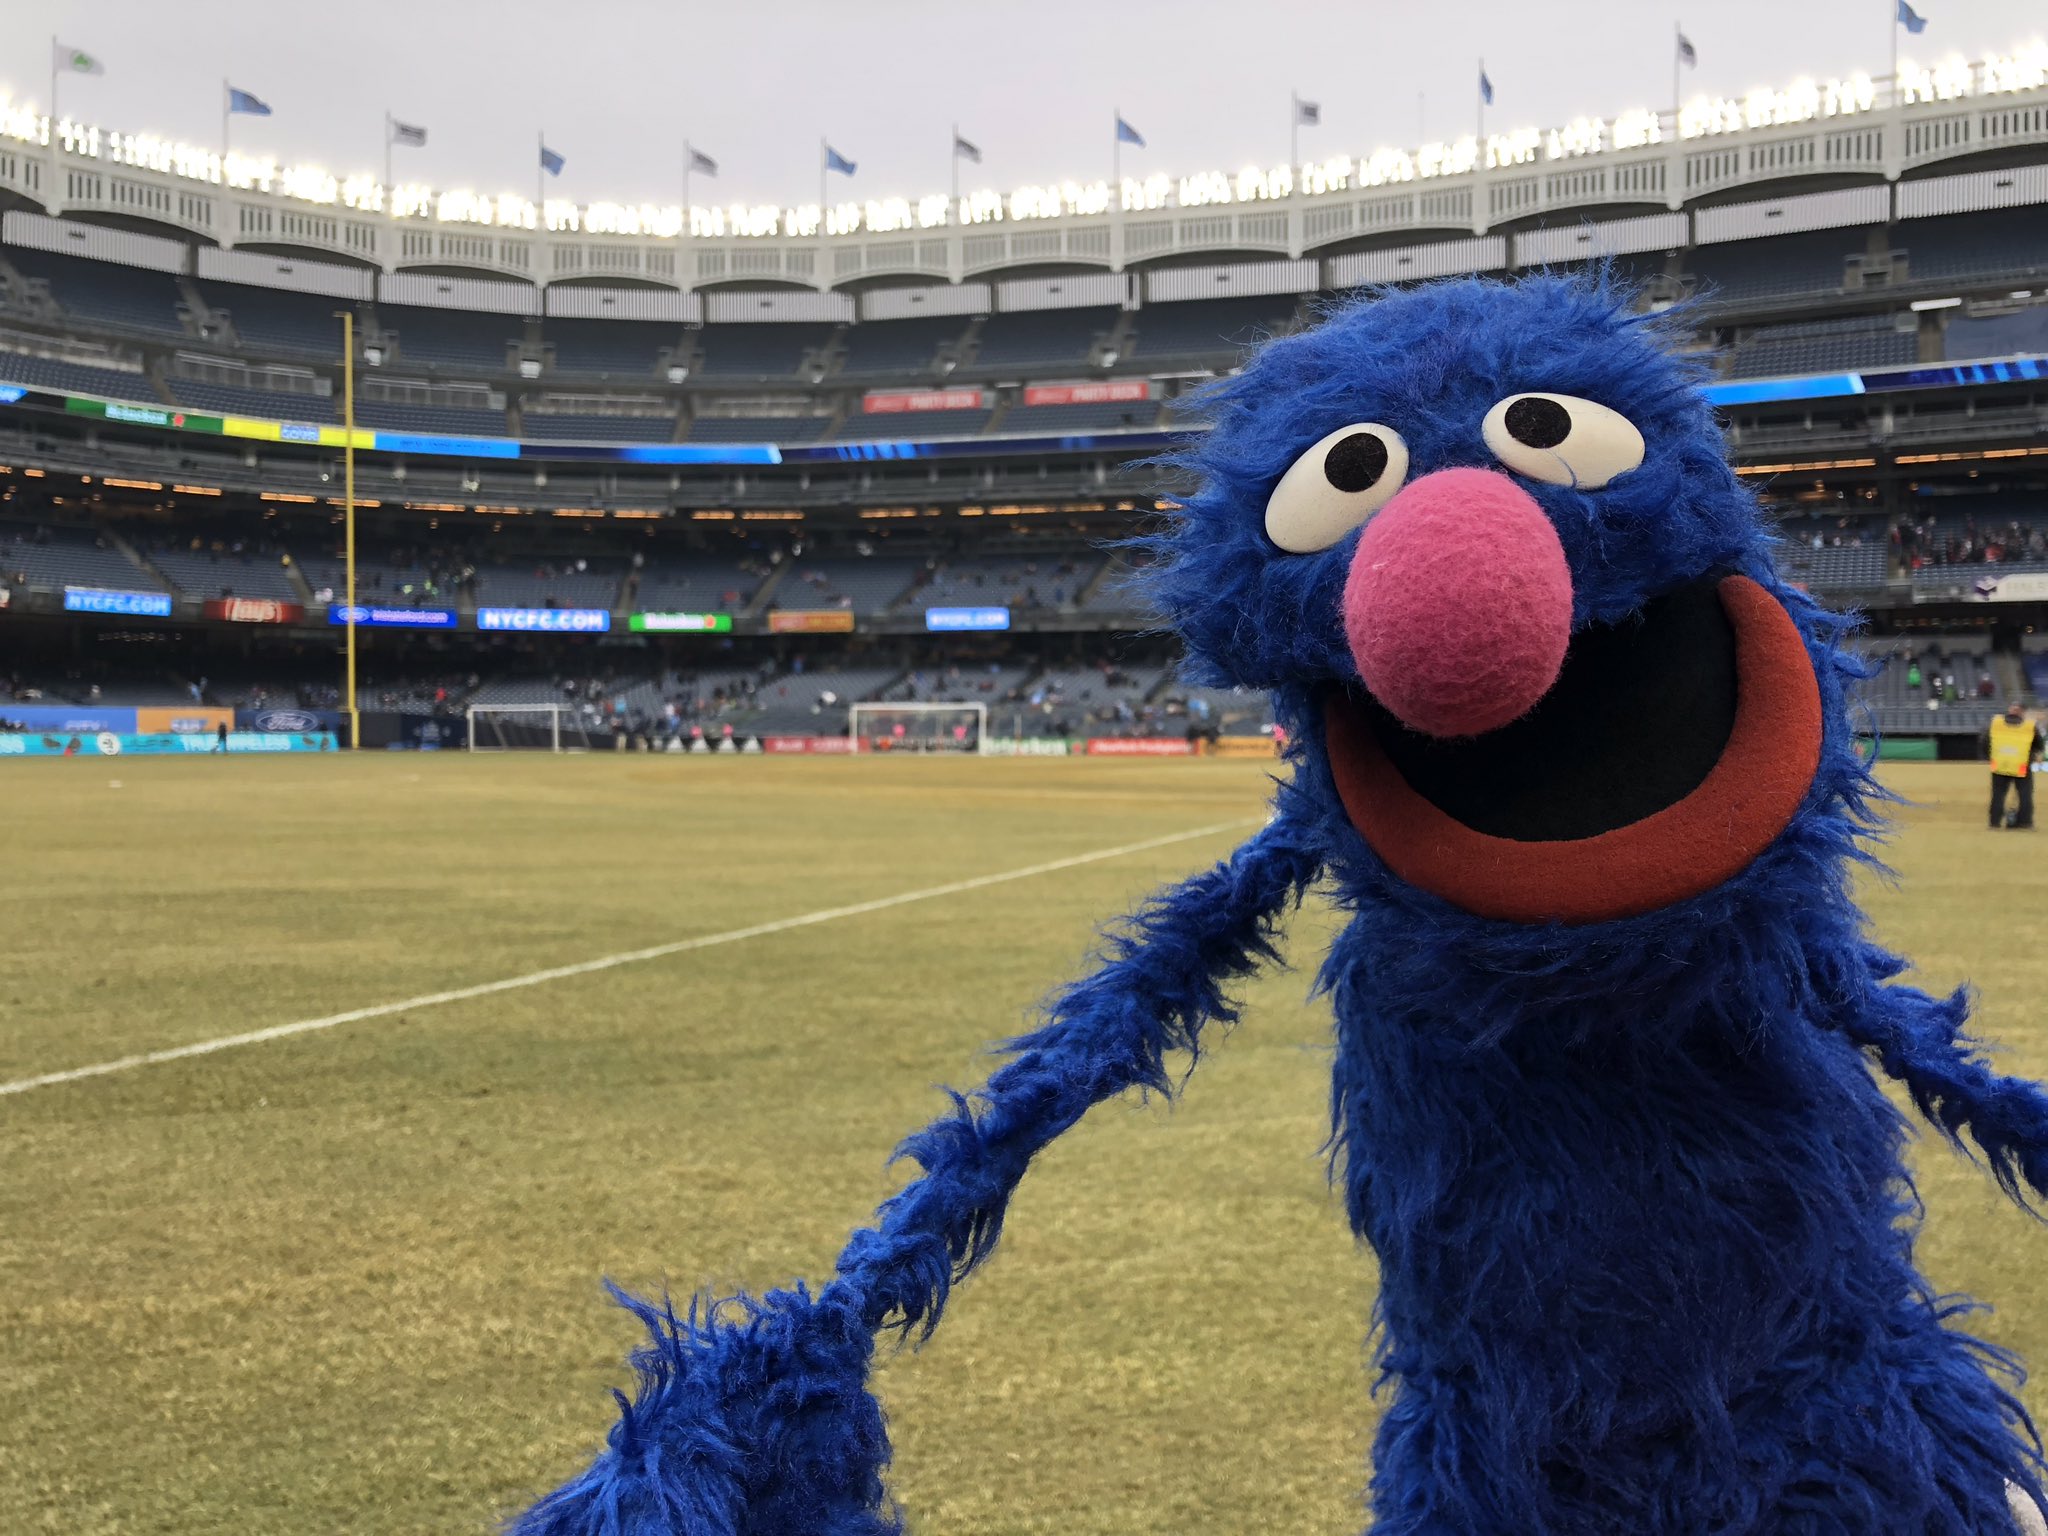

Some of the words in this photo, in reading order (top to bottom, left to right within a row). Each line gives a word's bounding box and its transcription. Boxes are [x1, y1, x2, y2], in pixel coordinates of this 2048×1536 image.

[68, 594, 169, 614] NYCFC.COM
[484, 610, 603, 630] NYCFC.COM
[267, 713, 305, 730] Ford
